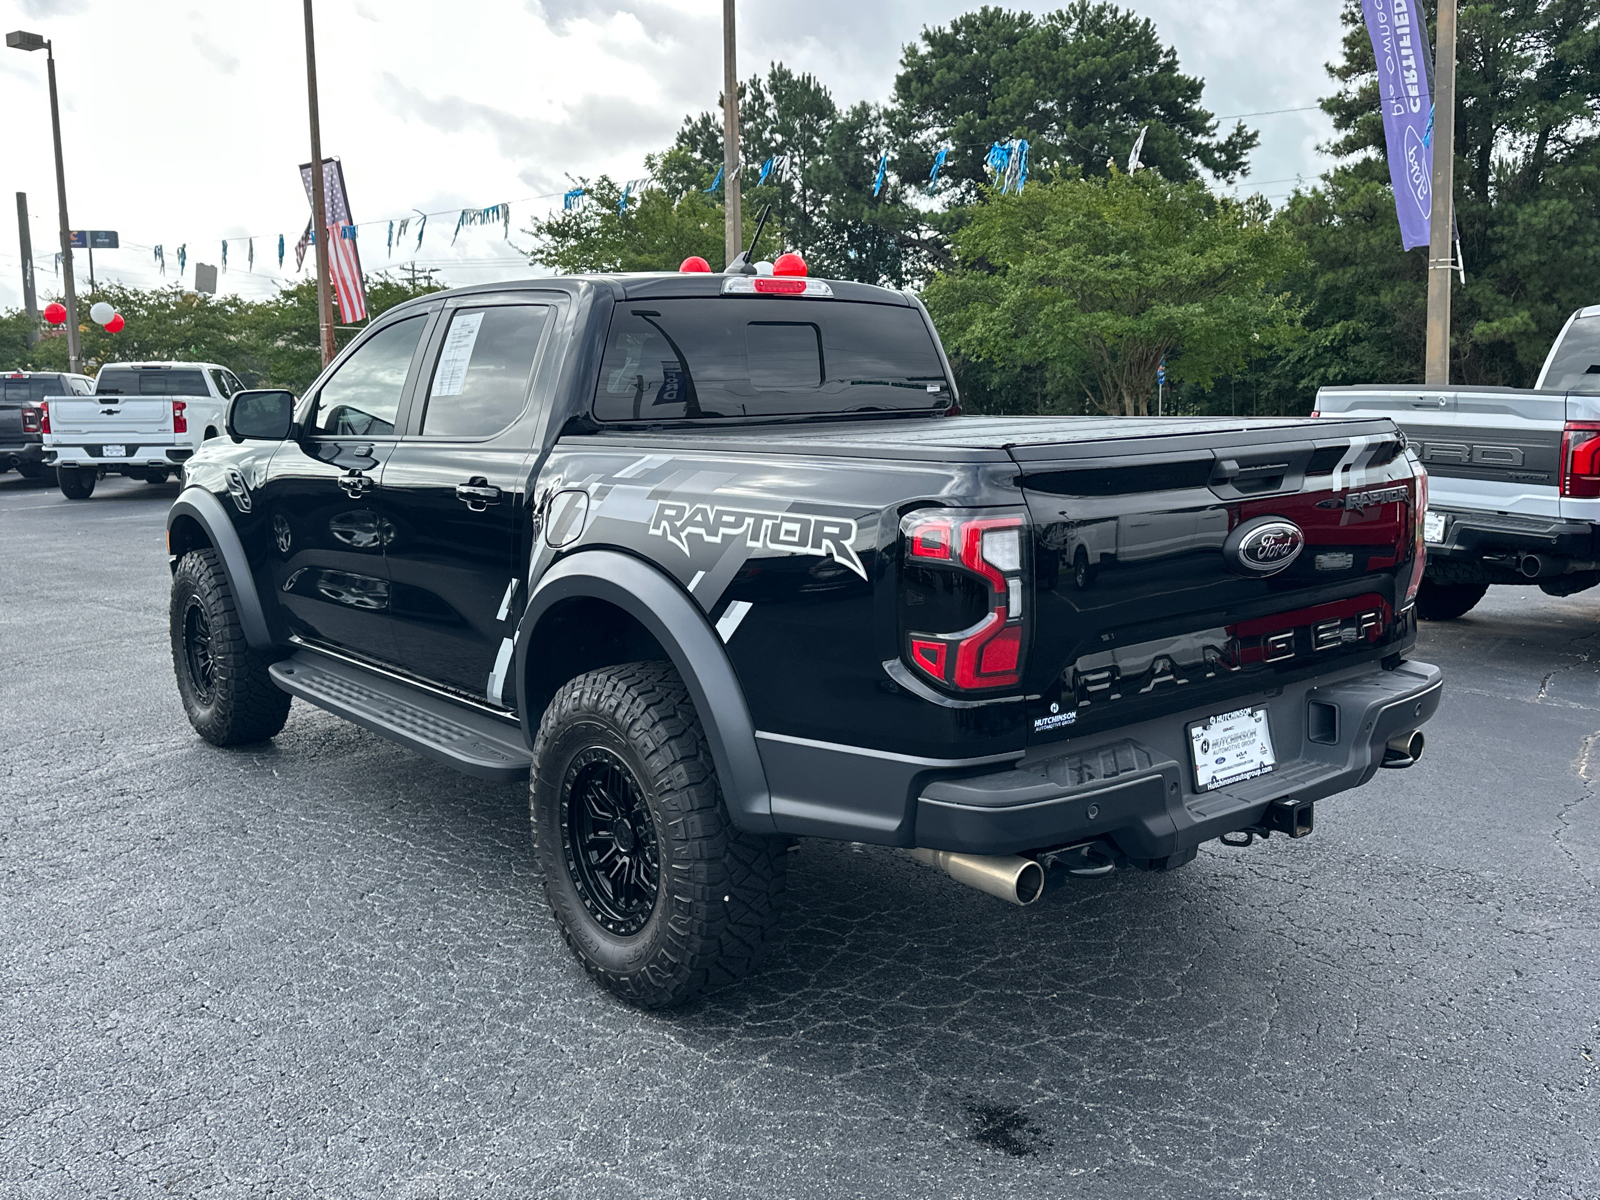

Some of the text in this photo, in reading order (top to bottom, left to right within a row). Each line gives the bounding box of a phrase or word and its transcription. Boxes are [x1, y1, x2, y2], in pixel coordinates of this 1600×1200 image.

[1407, 441, 1525, 466] RD
[1345, 485, 1411, 516] RAPTOR
[649, 499, 868, 581] RAPTOR
[1257, 532, 1292, 560] Ford
[1075, 606, 1384, 707] RANGER
[1034, 711, 1077, 727] HUTCHINSON
[1216, 707, 1252, 722] HUTCHINSON
[1211, 728, 1257, 750] HUTCHINSON
[1212, 738, 1256, 756] AUTOMOTIVE GROUP
[1207, 765, 1273, 790] Hutchinsonautogroup.com
